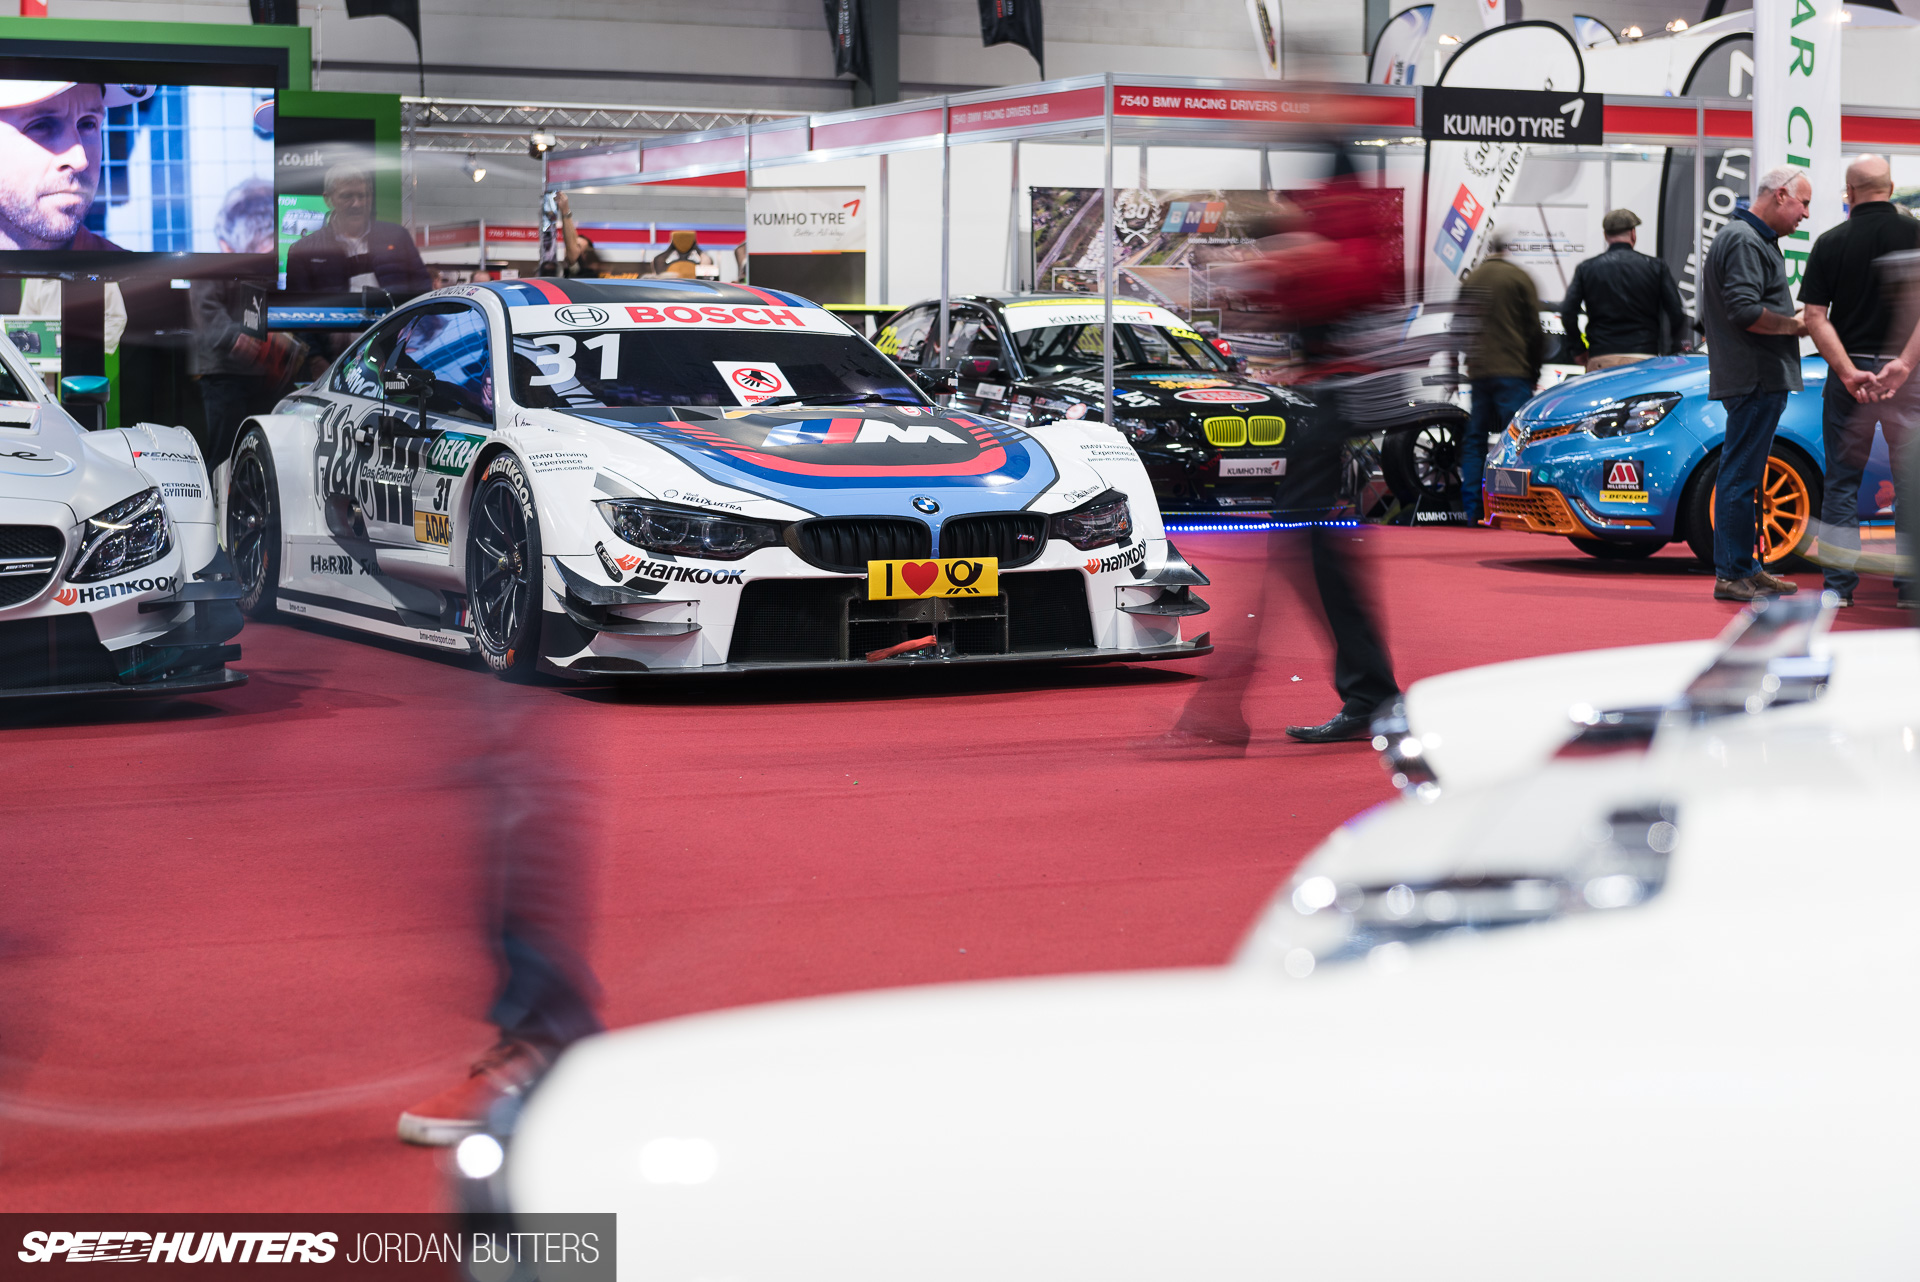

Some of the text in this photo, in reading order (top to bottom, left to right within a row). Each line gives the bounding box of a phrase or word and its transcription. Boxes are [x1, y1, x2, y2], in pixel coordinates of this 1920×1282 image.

[1119, 94, 1311, 114] 7540 BMW RACING DRIVERS CLUB
[967, 111, 981, 123] BMW
[983, 109, 1004, 120] RACING
[1006, 105, 1031, 118] DRIVERS
[1032, 103, 1049, 115] CLUB
[1443, 114, 1565, 139] KUMHO TYRE
[753, 212, 846, 226] KUMHO TYRE
[1124, 203, 1148, 219] 30
[1170, 210, 1221, 225] BMW
[624, 306, 806, 327] BOSCH
[529, 333, 620, 387] 31
[385, 381, 405, 390] PUMA
[139, 451, 199, 461] REMUS
[431, 437, 480, 469] DEKRA
[528, 453, 553, 461] BMW
[531, 459, 583, 468] Experience
[1226, 467, 1255, 475] KUMHO
[164, 488, 202, 499] SYNTIUM
[432, 477, 452, 512] 31
[682, 495, 743, 512] HELIX ULTRA
[1416, 511, 1468, 522] KUMHO TYRE
[419, 630, 456, 646] bmw-motorsport.com
